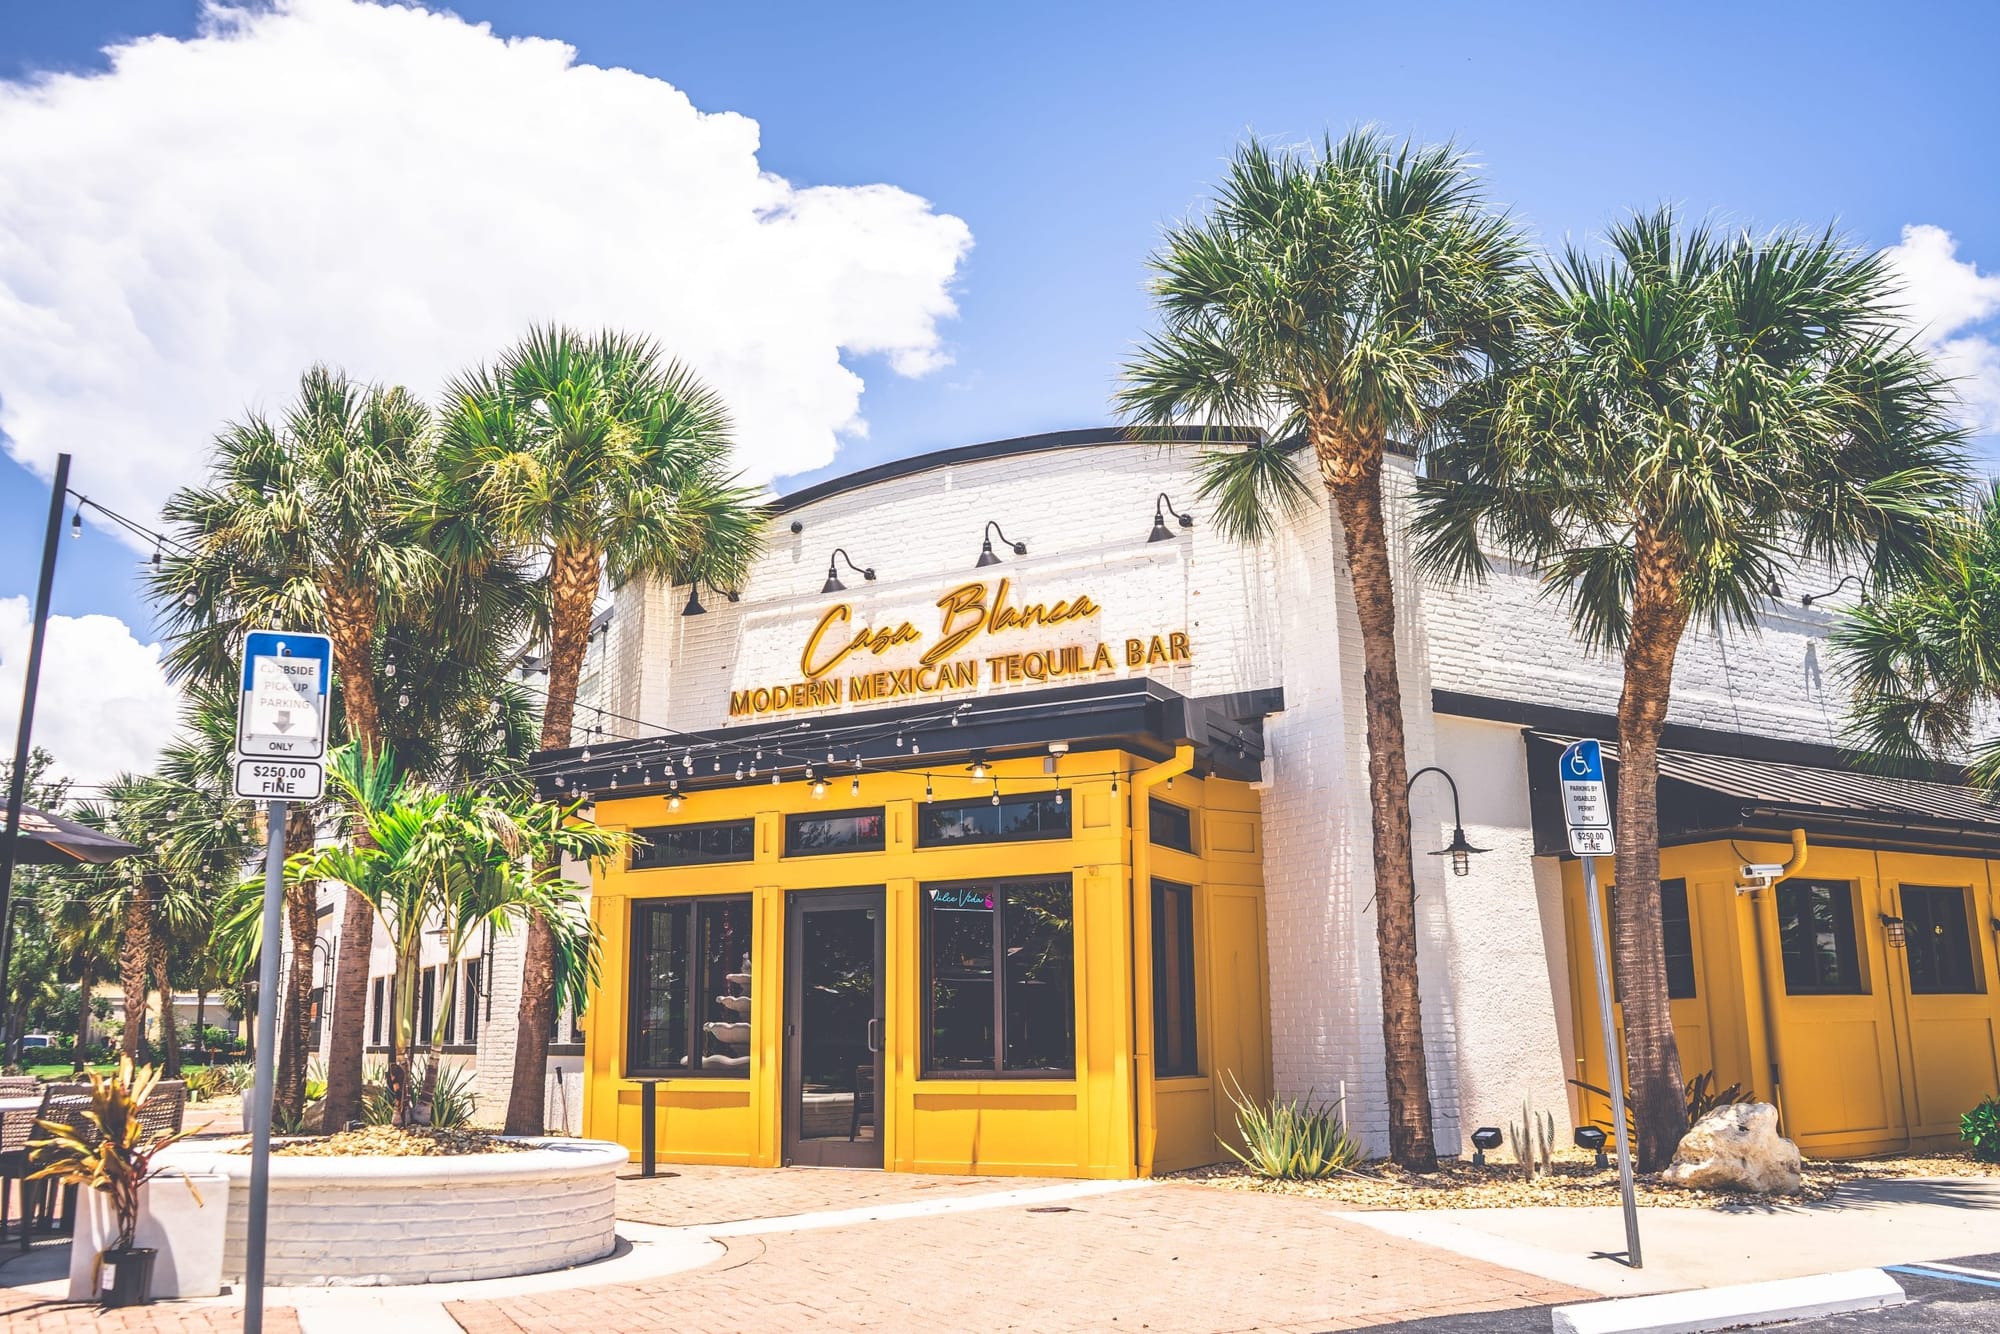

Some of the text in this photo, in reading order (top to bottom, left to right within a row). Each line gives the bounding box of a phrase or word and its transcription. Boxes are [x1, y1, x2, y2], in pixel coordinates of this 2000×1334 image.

[801, 577, 1102, 679] Casa Blanca
[729, 630, 1191, 716] MODERN MEXICAN TEQUILA BAR
[260, 698, 310, 710] PARKING
[269, 742, 294, 751] ONLY
[253, 766, 306, 778] $250.00
[262, 782, 296, 794] FINE
[959, 889, 984, 907] Vida
